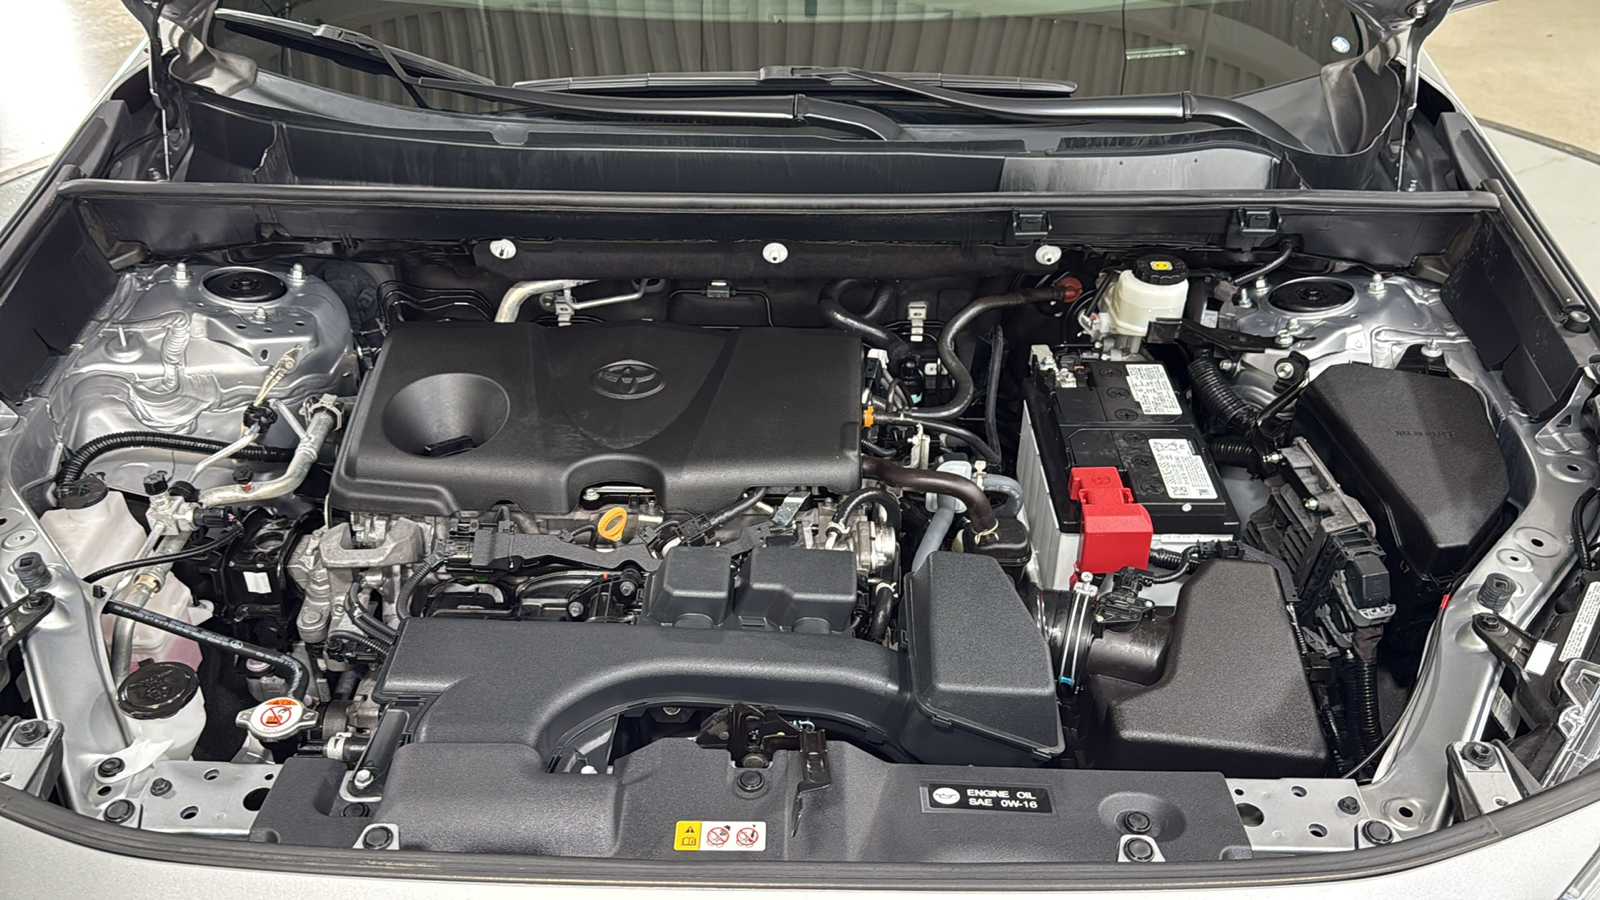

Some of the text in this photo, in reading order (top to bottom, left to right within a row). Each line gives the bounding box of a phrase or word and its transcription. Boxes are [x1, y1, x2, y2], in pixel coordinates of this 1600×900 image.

[966, 788, 1037, 800] ENGINE OIL
[968, 797, 1038, 809] SAE 0W-16
